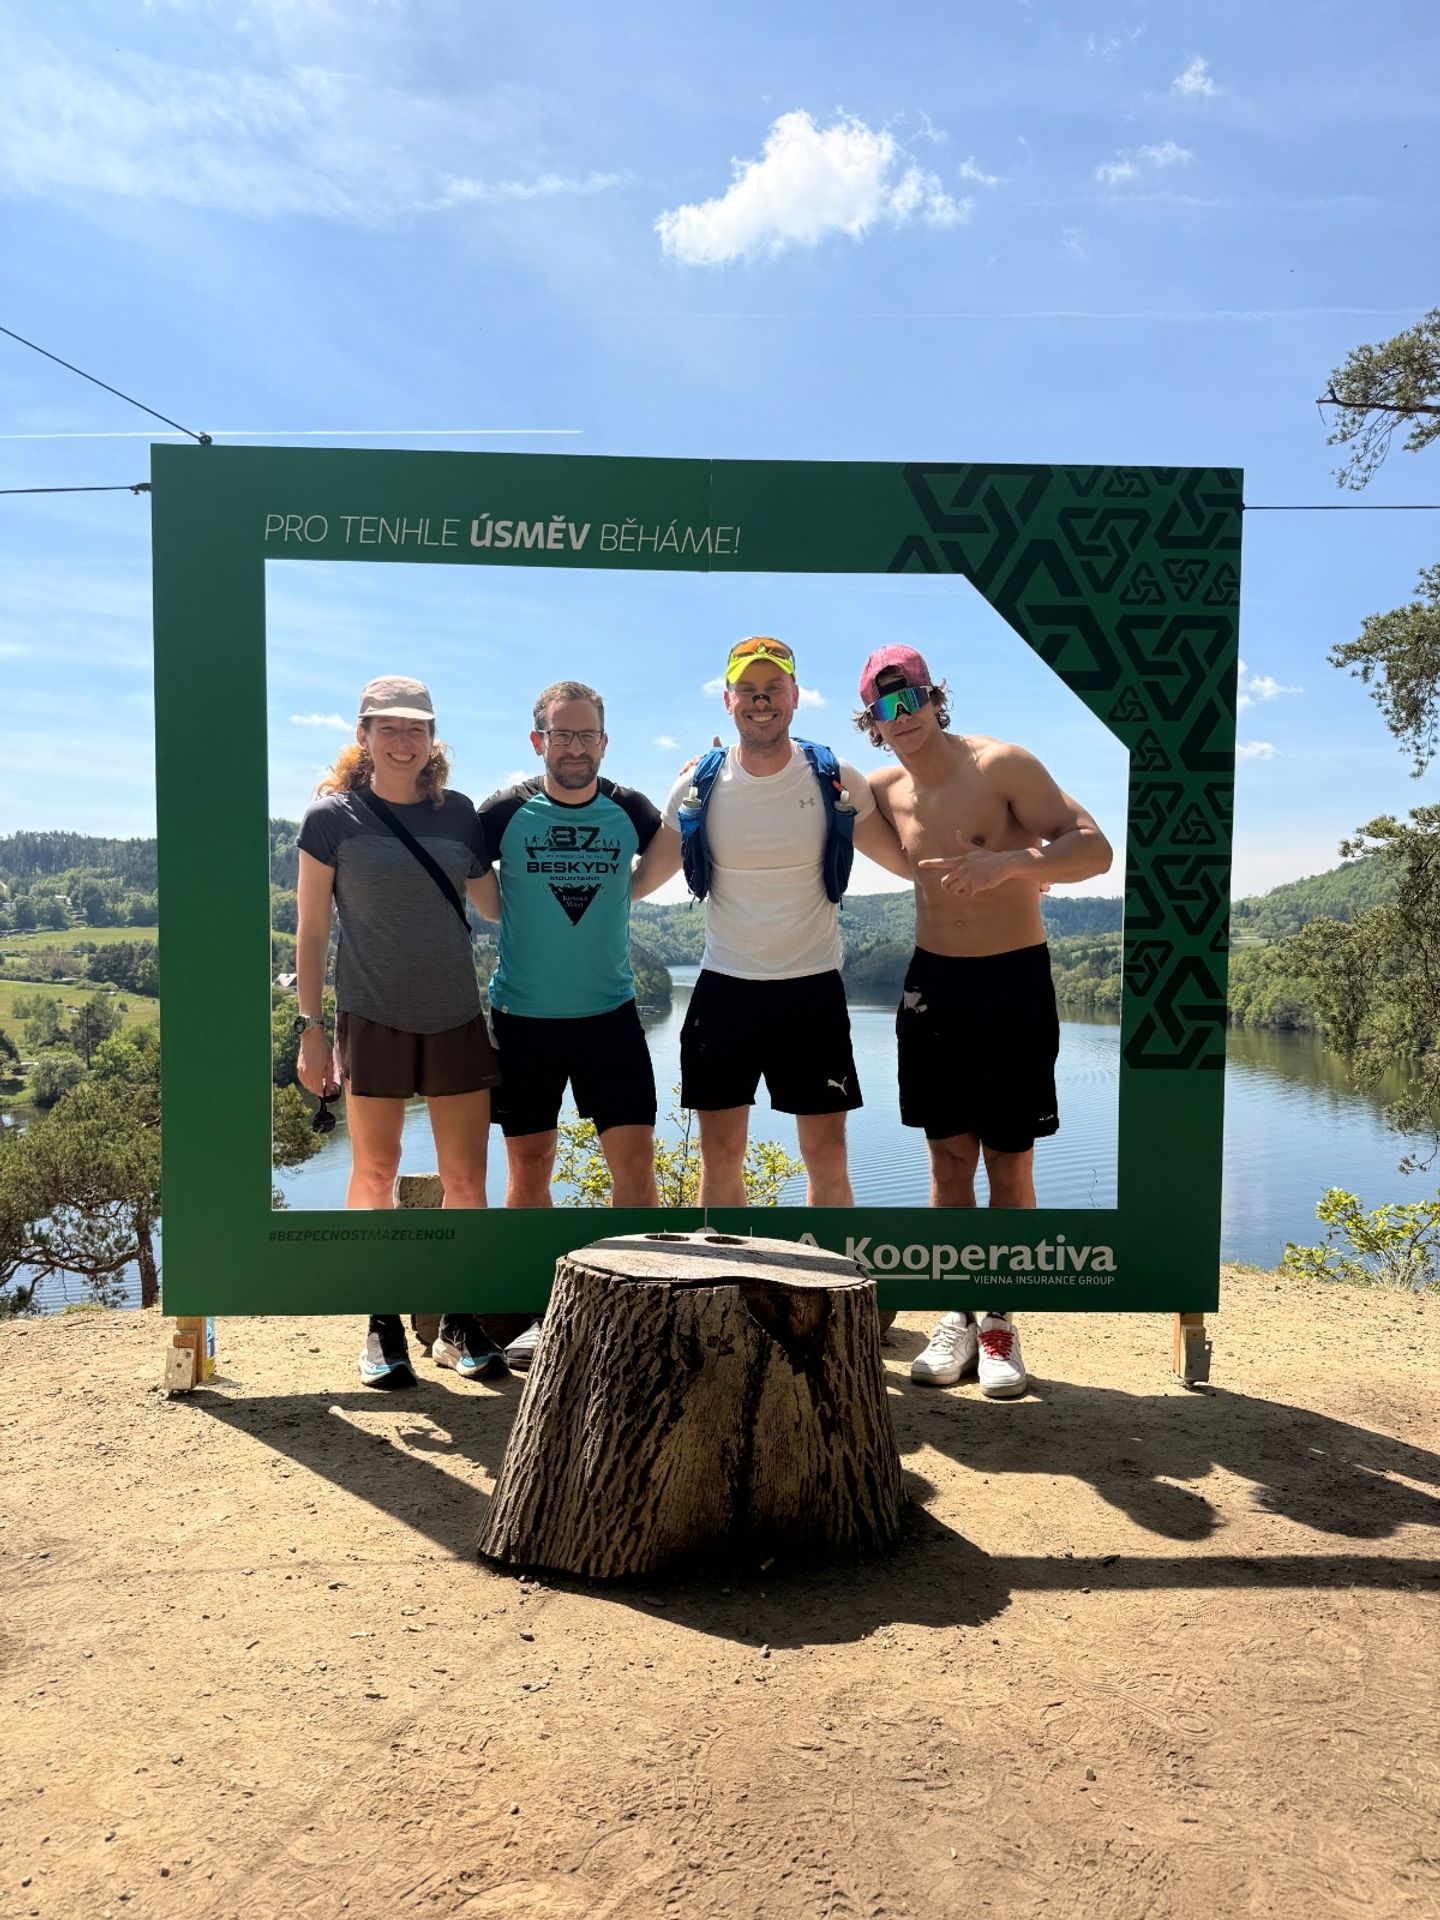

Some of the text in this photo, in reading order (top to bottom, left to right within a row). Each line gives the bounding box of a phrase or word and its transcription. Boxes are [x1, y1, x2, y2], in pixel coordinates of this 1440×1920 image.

[264, 512, 741, 554] PRO TENHLE ÚSMĚV BĚHÁME!
[526, 861, 620, 875] BESKYDY
[268, 1228, 456, 1242] #BEZPECNOSTMAZELENOU
[844, 1233, 1118, 1280] Kooperativa
[973, 1274, 1115, 1286] VIENNA INSURANCE GROUP
